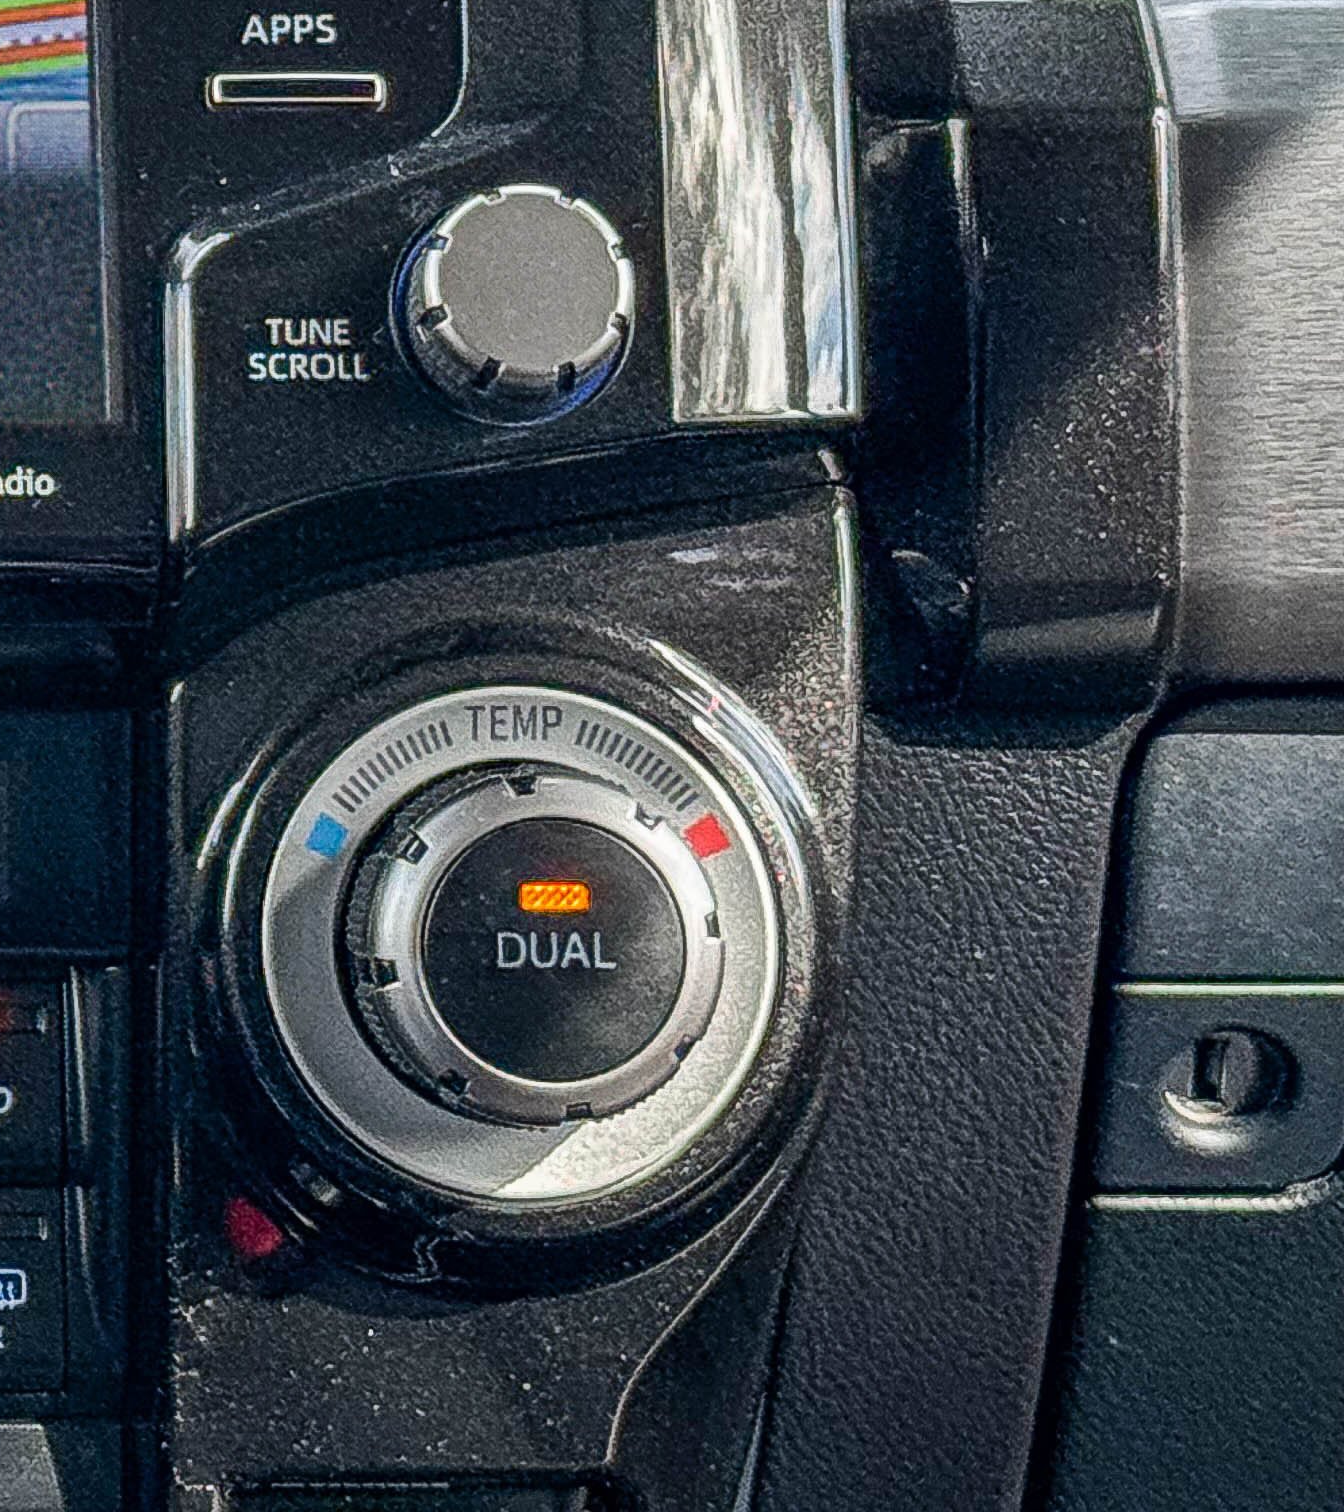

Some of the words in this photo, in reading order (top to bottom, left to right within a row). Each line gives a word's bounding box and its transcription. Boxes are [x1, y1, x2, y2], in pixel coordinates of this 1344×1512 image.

[241, 14, 338, 45] APPS
[265, 318, 352, 347] TUNE
[247, 352, 372, 382] SCROLL
[464, 705, 563, 742] TEMP
[497, 931, 618, 971] DUAL
